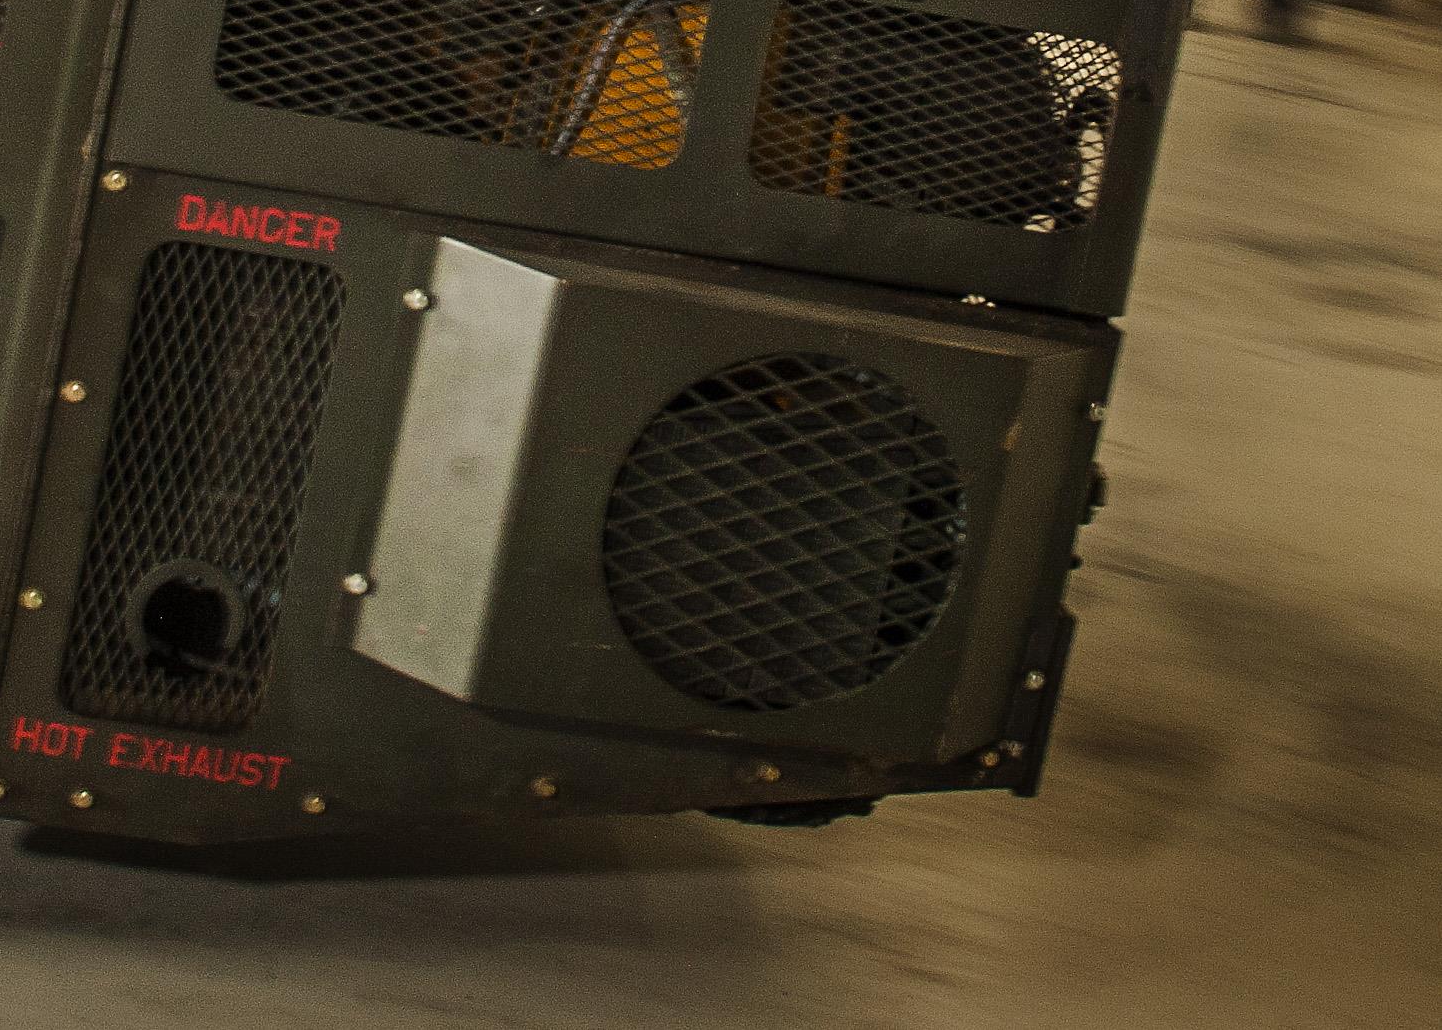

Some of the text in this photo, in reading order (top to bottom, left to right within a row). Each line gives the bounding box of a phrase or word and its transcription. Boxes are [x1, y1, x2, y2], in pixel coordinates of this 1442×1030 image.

[175, 193, 343, 253] DANGER
[11, 715, 293, 791] HOT EXHAUST
